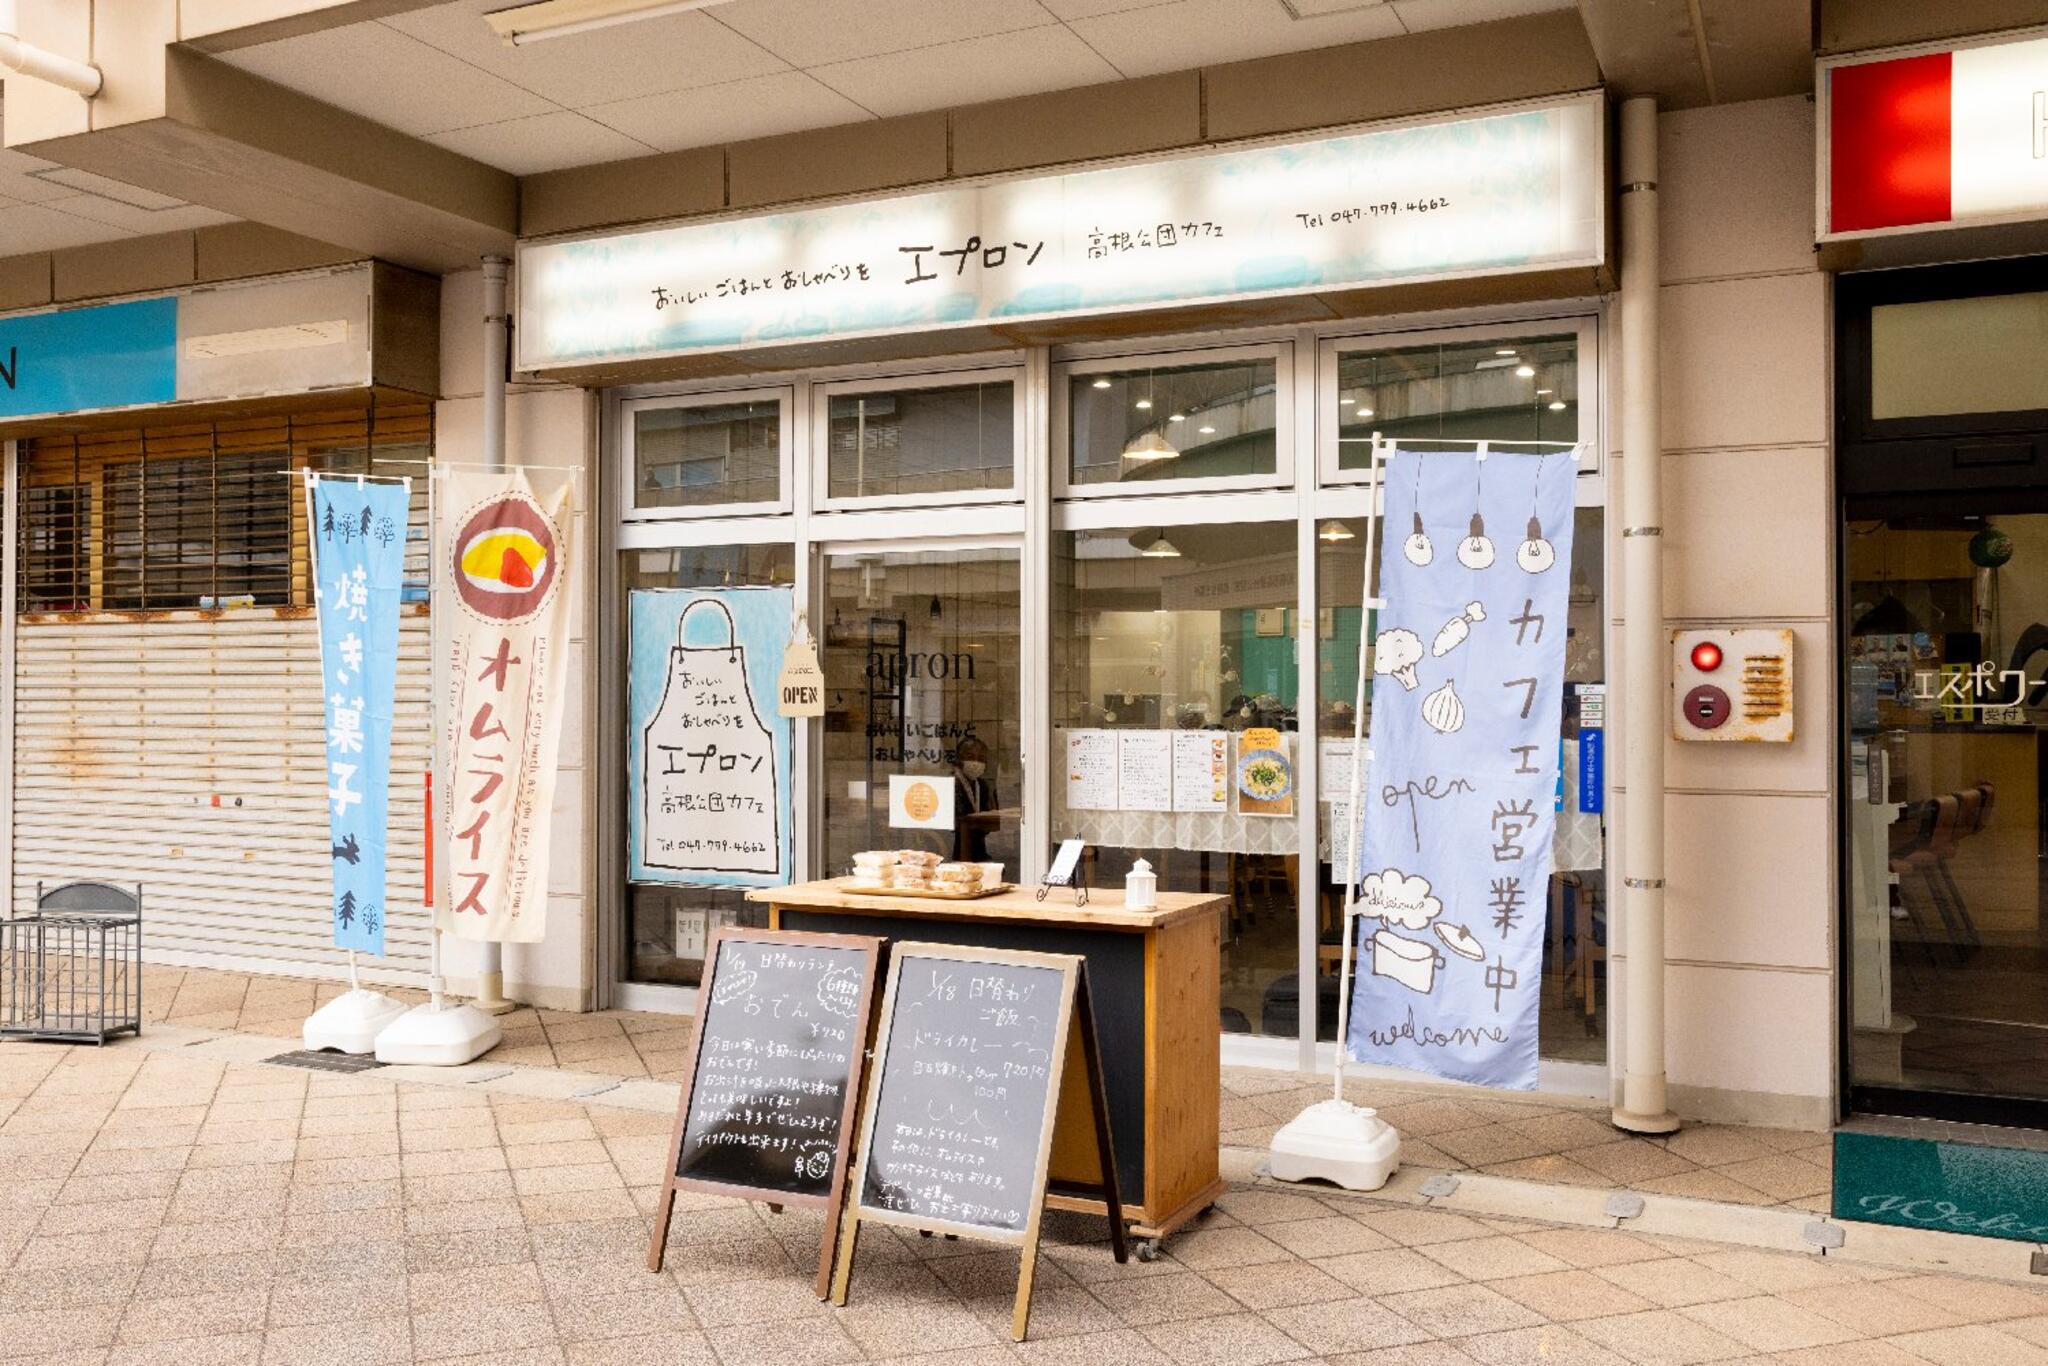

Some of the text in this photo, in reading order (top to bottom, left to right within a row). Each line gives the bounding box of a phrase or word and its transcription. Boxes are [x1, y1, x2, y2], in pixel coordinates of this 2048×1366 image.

[899, 235, 1044, 284] エプロン
[1296, 212, 1324, 229] Tel
[1330, 197, 1451, 224] 047.779.4662
[328, 563, 368, 817] 焼き菓子
[678, 671, 723, 689] おいしい
[865, 650, 976, 690] apron
[1913, 660, 2047, 708] エスポワー
[695, 692, 738, 706] ごはんと
[782, 686, 818, 705] OPEN
[681, 713, 744, 729] おしゃべりを
[455, 637, 521, 916] オムライス
[657, 744, 763, 775] エプロン
[1383, 774, 1477, 853] open
[1485, 598, 1545, 1013] カフェ営業中
[657, 838, 675, 853] Tel
[744, 993, 809, 1019] おでん
[1368, 1003, 1509, 1047] welcome
